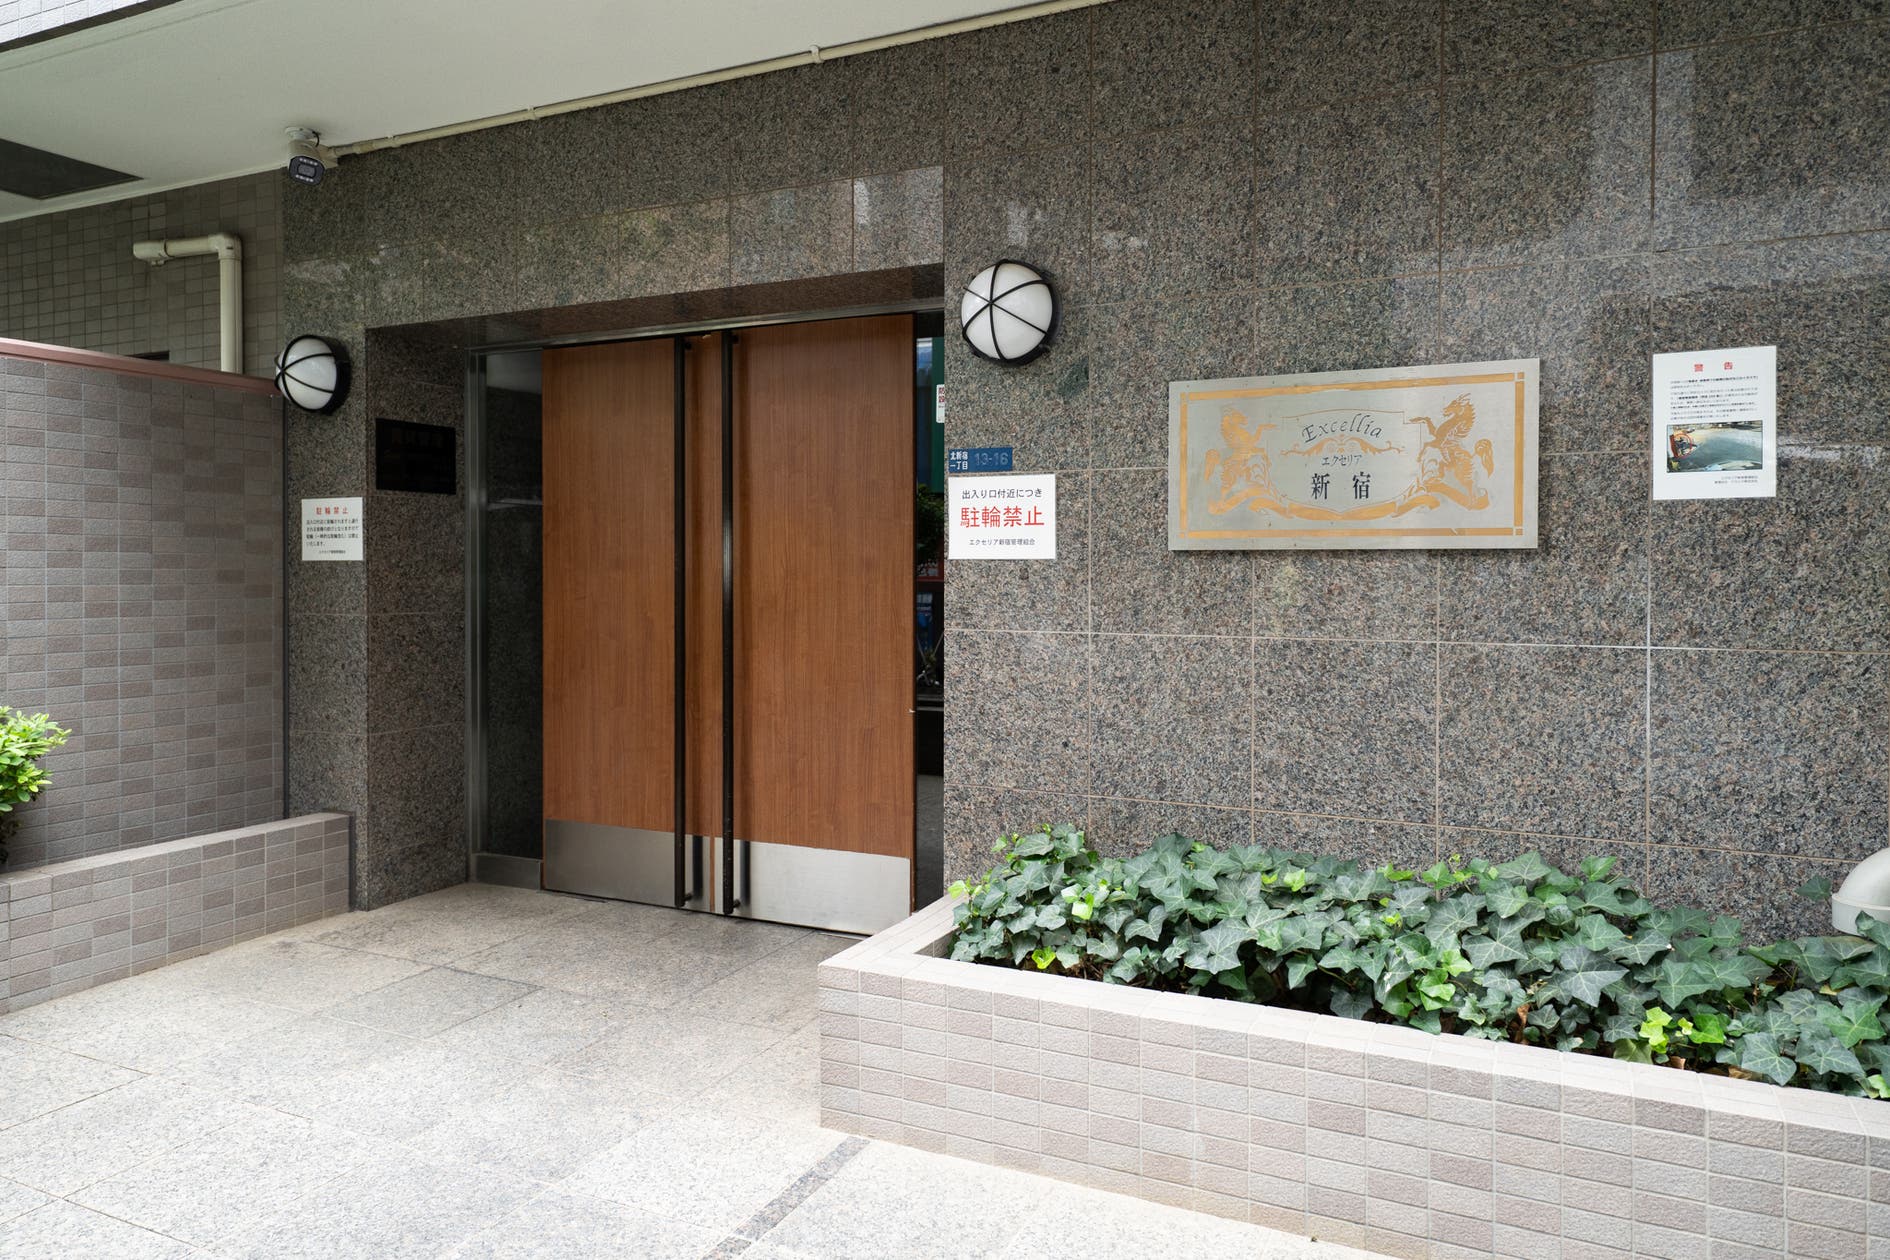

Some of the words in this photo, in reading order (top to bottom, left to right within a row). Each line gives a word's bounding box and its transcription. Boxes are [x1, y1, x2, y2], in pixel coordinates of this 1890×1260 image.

[1302, 412, 1383, 443] Excellia
[949, 461, 969, 470] 一丁目
[974, 451, 1009, 467] 13-16
[1321, 454, 1363, 467] エクセリア
[1310, 471, 1372, 500] 新宿
[961, 488, 1043, 500] 出入り口付近につき
[960, 505, 1045, 529] 駐輪禁止
